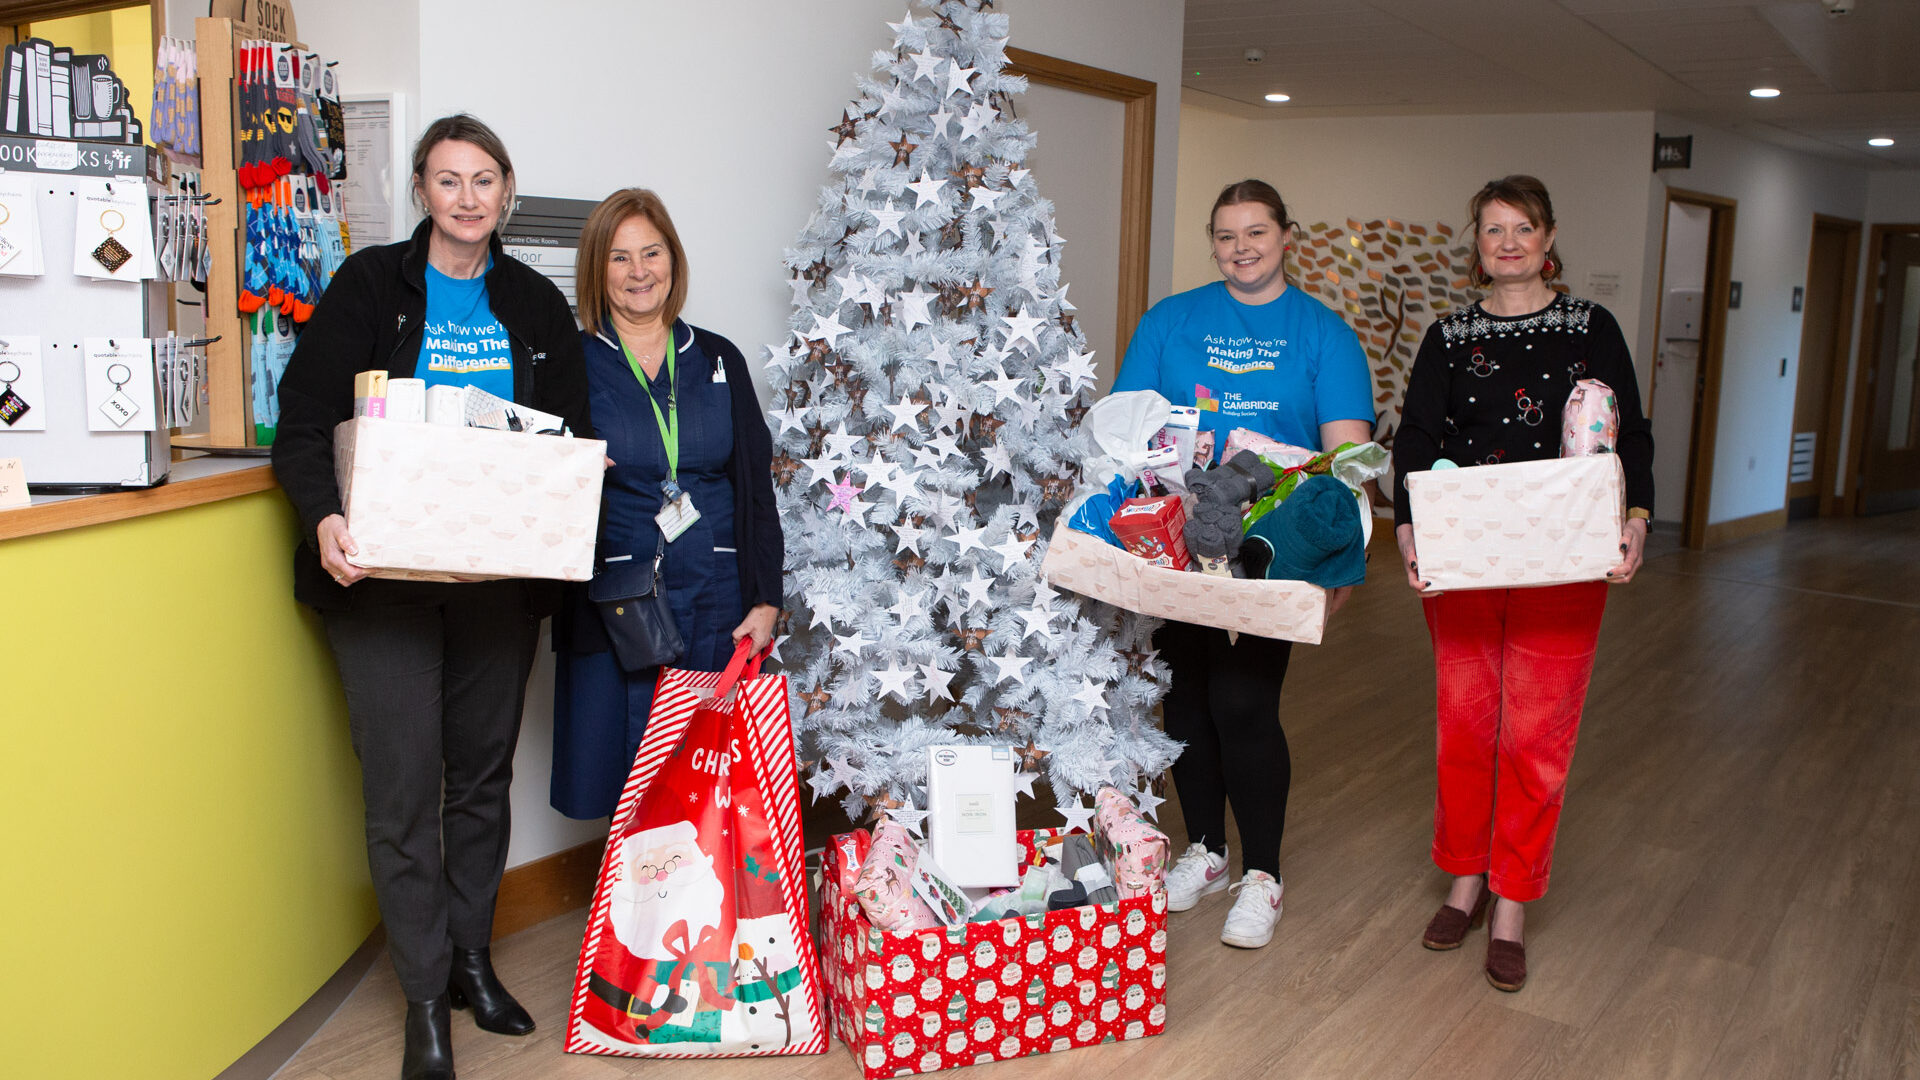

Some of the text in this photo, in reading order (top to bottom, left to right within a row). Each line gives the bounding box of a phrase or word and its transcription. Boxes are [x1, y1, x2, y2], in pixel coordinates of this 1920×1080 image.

[257, 0, 286, 34] SOCK
[104, 153, 114, 171] by
[507, 236, 526, 244] Centre
[525, 237, 541, 245] Clinic
[540, 238, 560, 246] Rooms
[511, 247, 543, 264] Floor
[424, 320, 446, 336] Ask
[447, 319, 471, 336] how
[426, 336, 510, 355] Making The
[1203, 333, 1288, 348] Ask how we're
[1206, 345, 1281, 360] Making The
[429, 353, 510, 371] Difference
[1208, 355, 1275, 372] Difference
[1223, 392, 1242, 401] THE
[110, 400, 129, 417] XOXO
[1222, 400, 1280, 411] CAMBRIDGE
[1222, 409, 1241, 417] Building
